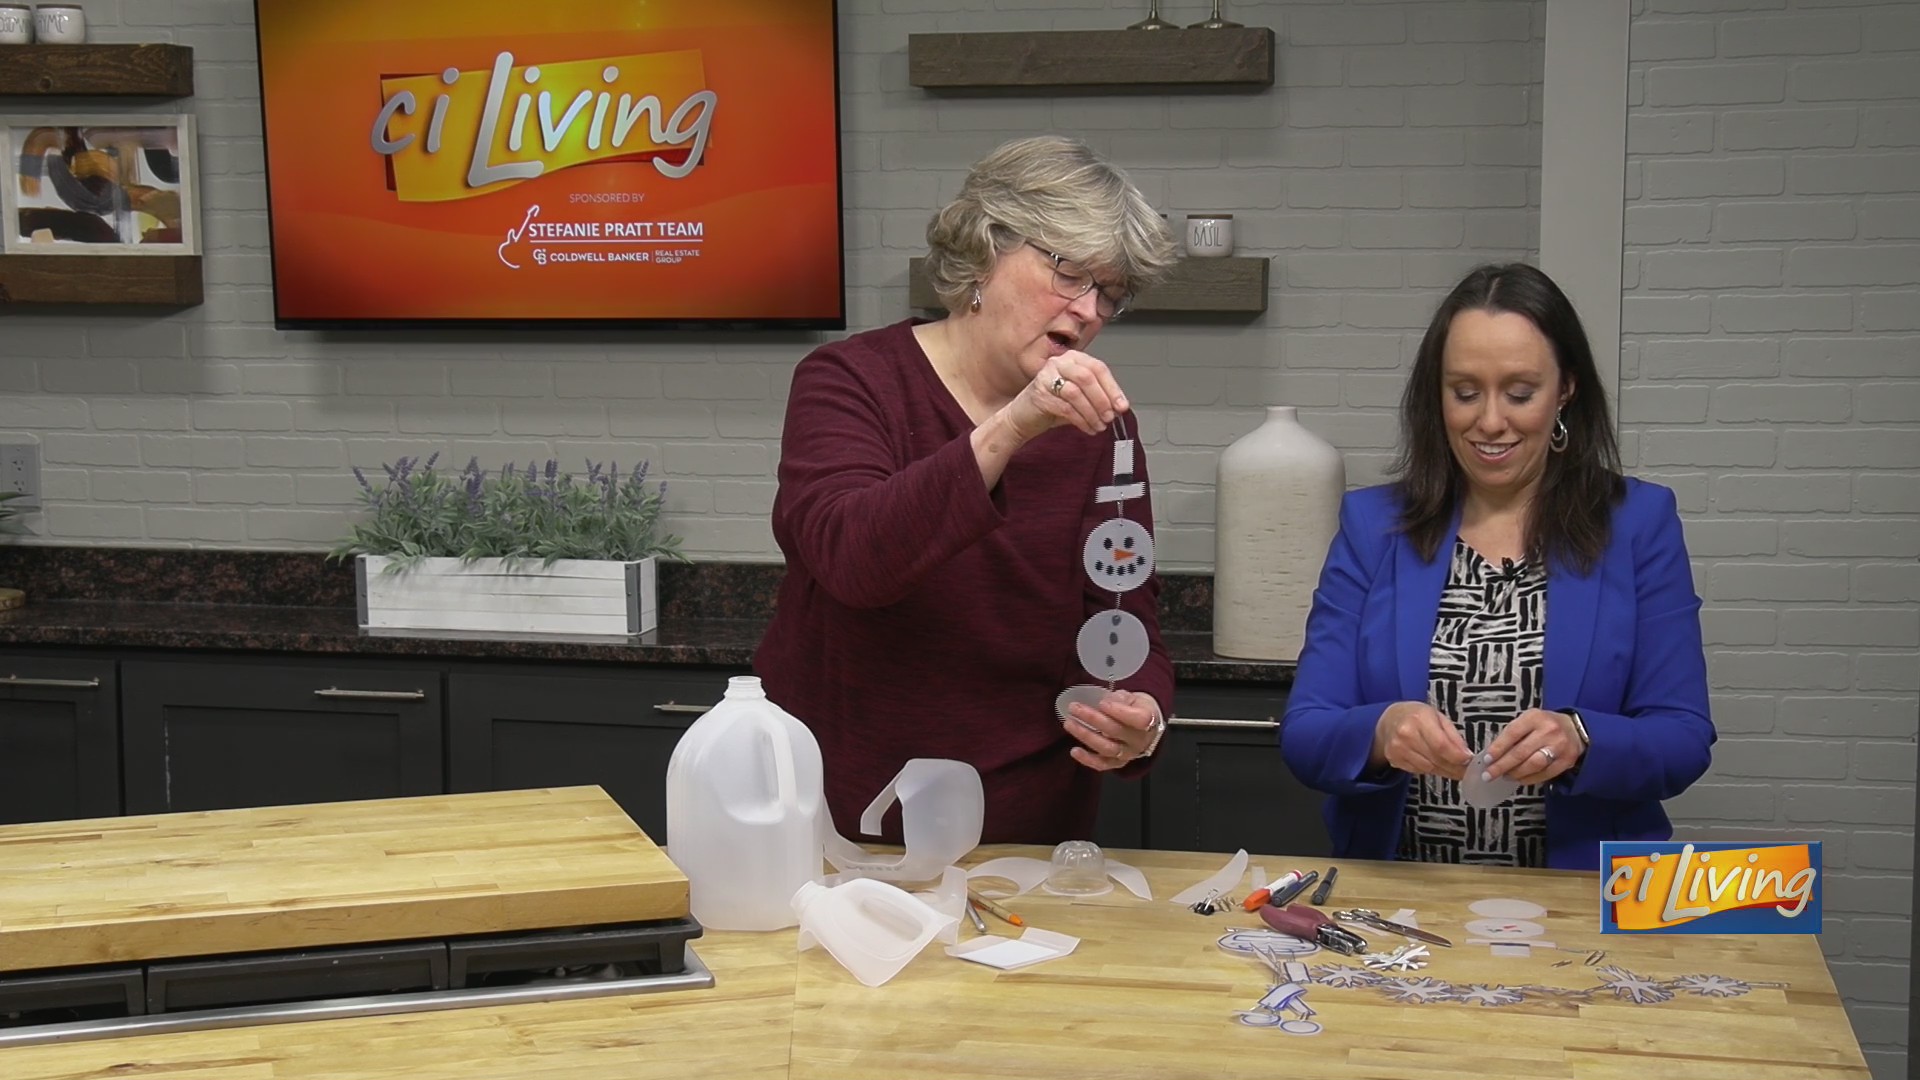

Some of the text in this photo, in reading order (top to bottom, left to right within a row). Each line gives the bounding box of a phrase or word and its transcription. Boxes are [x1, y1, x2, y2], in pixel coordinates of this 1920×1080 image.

[370, 51, 718, 188] ci Living
[569, 193, 645, 203] SPONSORED BY
[528, 222, 704, 237] STEFANIE PRATT TEAM
[1193, 226, 1223, 247] BASIL
[550, 252, 606, 262] COLDWELL
[607, 252, 649, 262] BANKER
[655, 249, 700, 257] REAL ESTATE
[655, 256, 682, 264] GROUP
